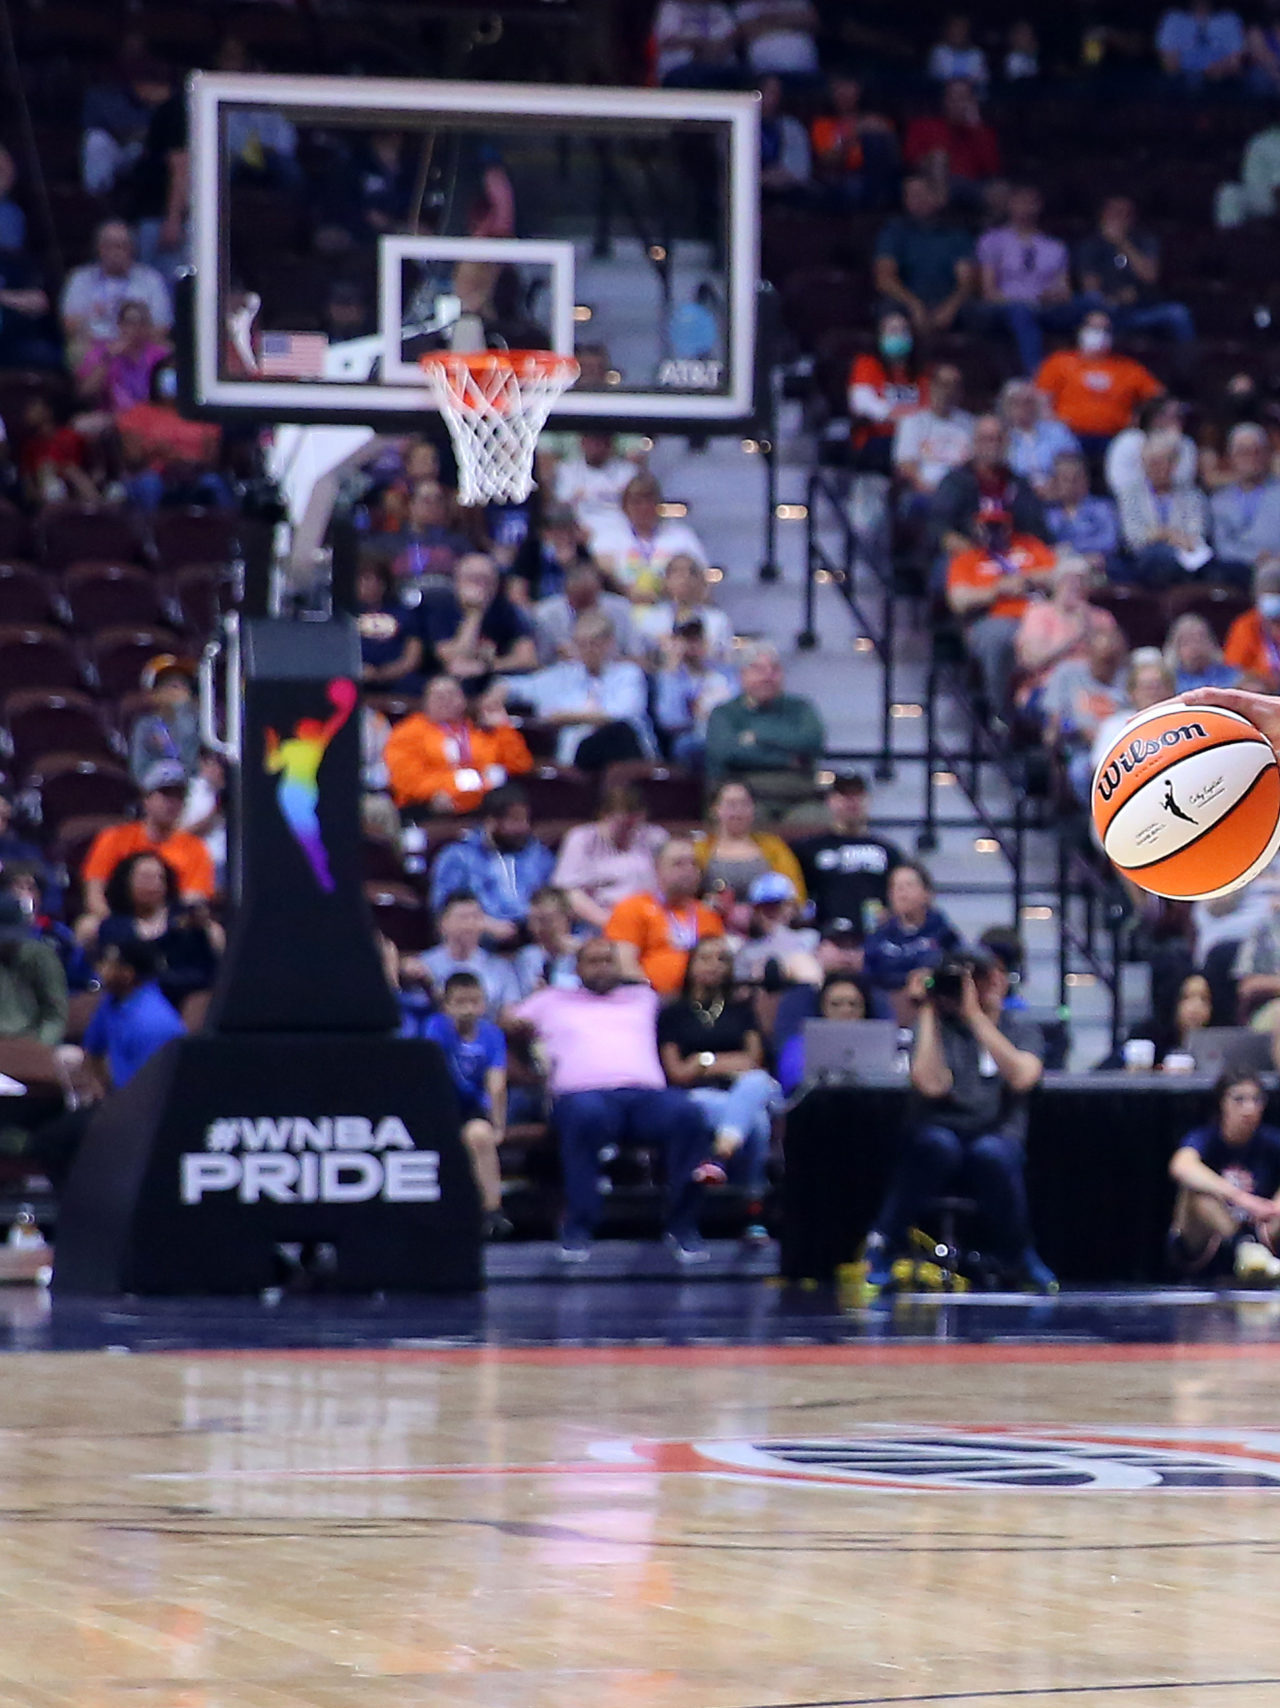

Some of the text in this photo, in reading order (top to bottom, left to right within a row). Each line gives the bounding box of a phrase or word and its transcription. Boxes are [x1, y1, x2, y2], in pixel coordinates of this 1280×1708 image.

[1097, 723, 1209, 802] Wilson
[206, 1115, 415, 1150] #WNBA
[181, 1151, 441, 1203] PRIDE
